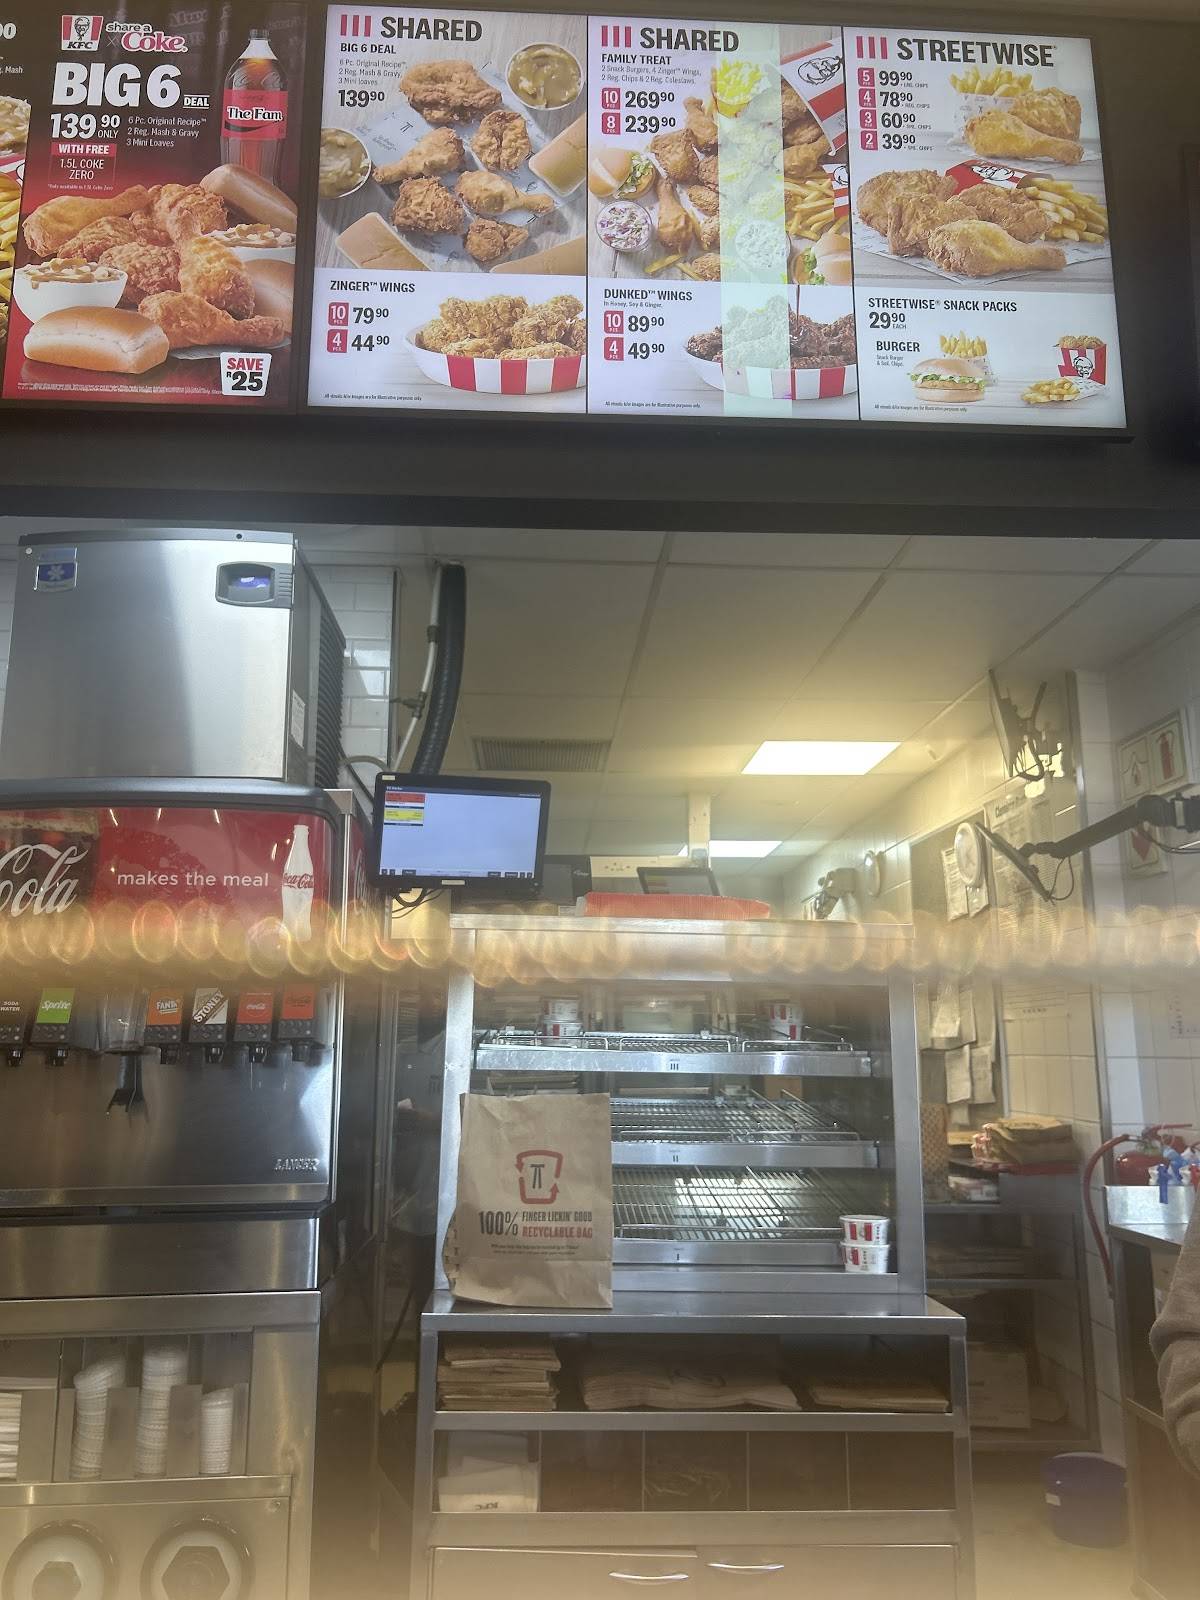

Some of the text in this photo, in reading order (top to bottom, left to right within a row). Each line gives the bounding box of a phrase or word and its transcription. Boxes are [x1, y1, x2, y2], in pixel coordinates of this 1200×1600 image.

[106, 22, 152, 33] share a
[381, 16, 483, 42] SHARED
[640, 27, 739, 52] SHARED
[67, 41, 93, 50] KFC
[340, 43, 396, 54] BIG 6 DEAL
[356, 59, 380, 67] Original
[601, 53, 672, 65] FAMILY TREAT
[339, 67, 344, 75] 2
[862, 70, 870, 82] 5
[338, 77, 343, 85] 3
[621, 75, 639, 83] Chips
[52, 62, 210, 108] BIG 6 DEAL
[604, 91, 618, 104] 10
[863, 91, 871, 102] 4
[227, 106, 283, 121] The Fam
[864, 112, 872, 123] 3
[128, 117, 134, 125] 6
[147, 116, 176, 127] Original
[606, 115, 616, 128] 8
[97, 129, 119, 139] ONLY
[127, 128, 200, 139] 2 Reg. Mash & Gravy
[866, 133, 873, 144] 2
[126, 138, 175, 148] 3 Mini Loaves
[59, 144, 109, 155] WITH FREE
[60, 158, 104, 169] 1.5L COKE
[69, 170, 94, 180] ZERO
[380, 282, 416, 293] WINGS
[657, 290, 693, 301] WINGS
[943, 300, 979, 311] SNACK
[983, 301, 1017, 312] PACKS
[331, 305, 346, 319] 10
[606, 314, 621, 328] 10
[332, 332, 342, 346] 4
[609, 341, 618, 355] 4
[876, 341, 920, 352] BURGER
[227, 358, 264, 371] SAVE
[117, 871, 270, 887] makes the meal
[41, 1000, 72, 1011] Sprite
[193, 990, 225, 1023] STONEY
[479, 1211, 519, 1237] 100%
[522, 1211, 547, 1222] FINGER
[574, 1212, 593, 1222] GOOD
[522, 1226, 593, 1238] RECYCLABLE BAG
